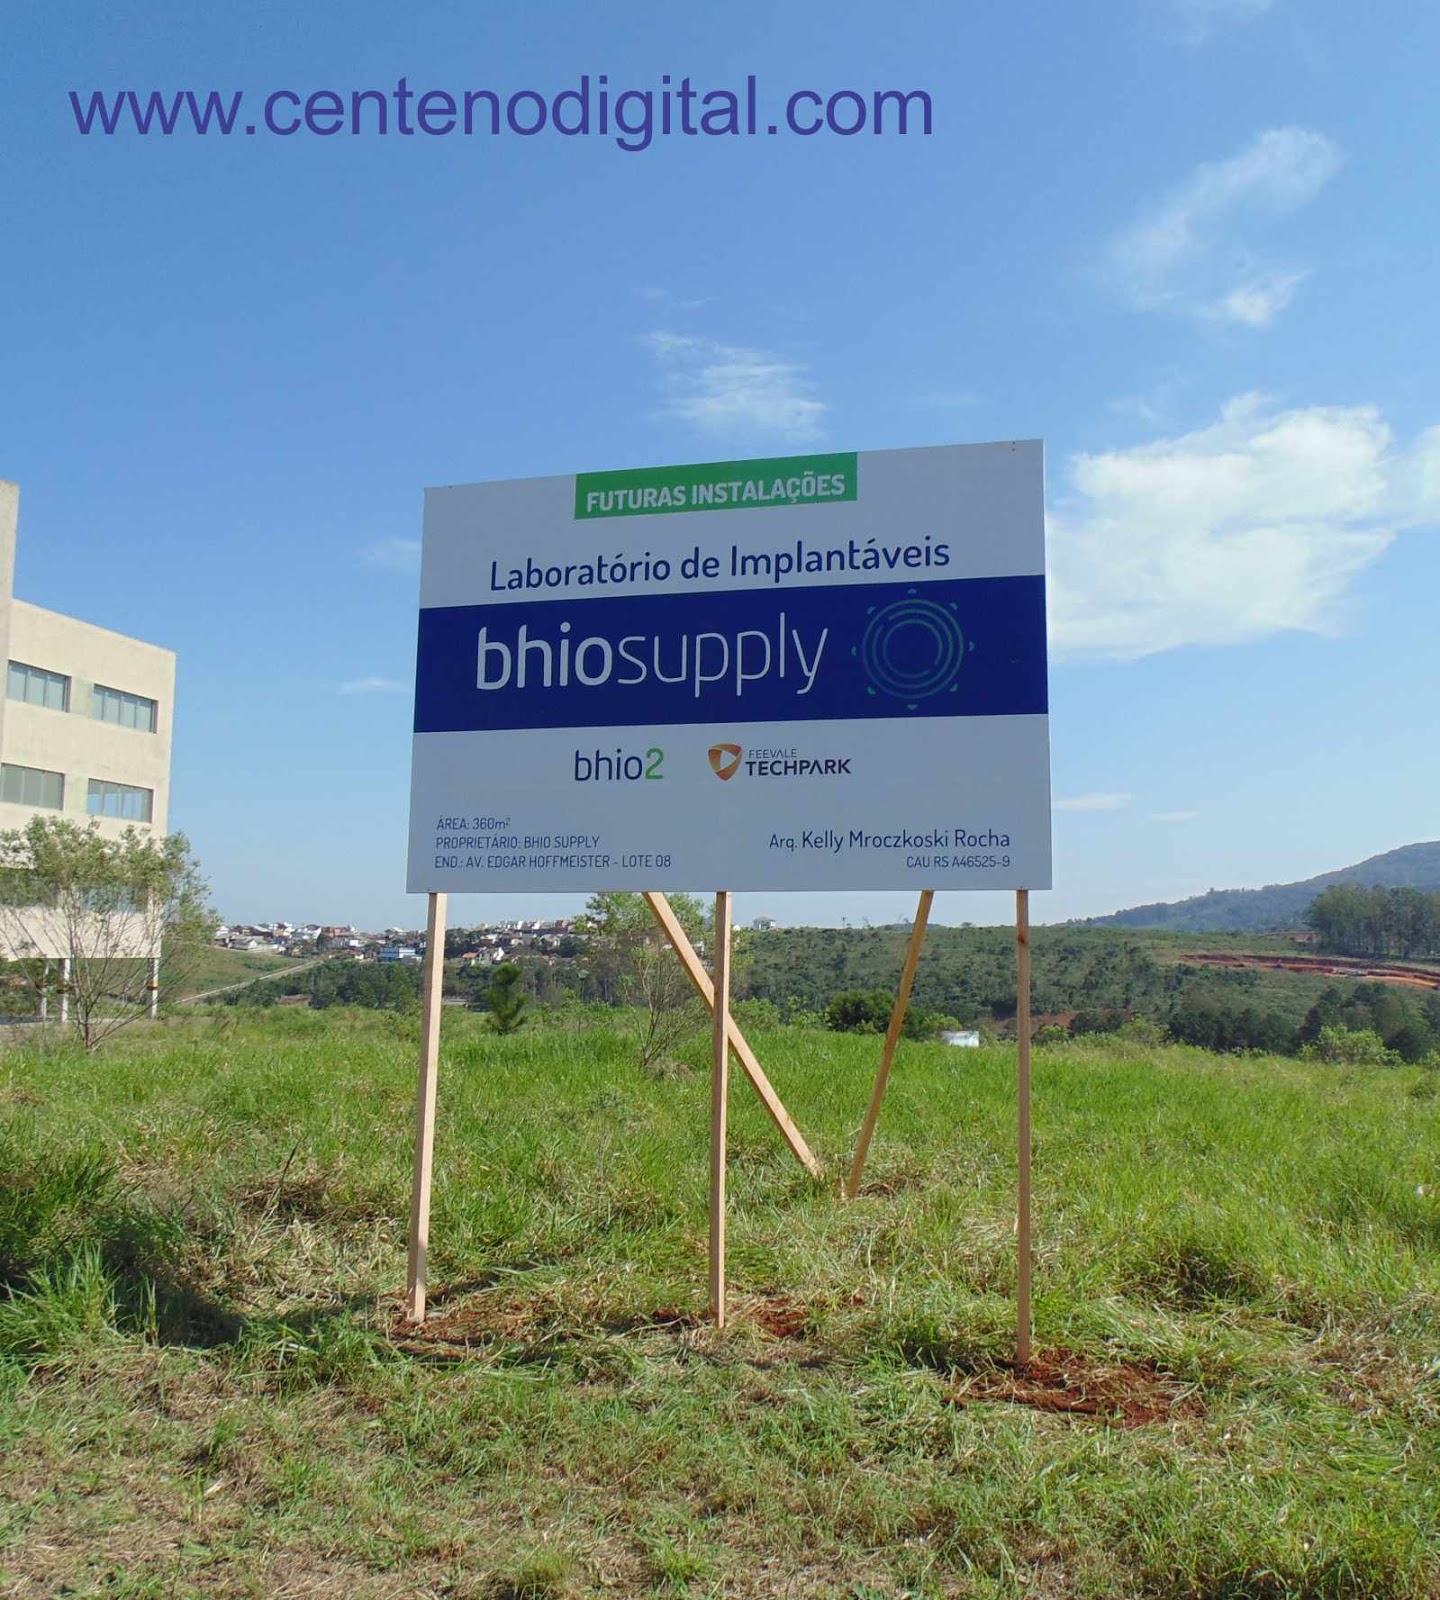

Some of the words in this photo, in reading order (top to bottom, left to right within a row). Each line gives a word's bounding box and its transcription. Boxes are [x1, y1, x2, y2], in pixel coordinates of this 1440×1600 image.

[586, 485, 686, 512] FUTURAS
[691, 470, 846, 506] INSTALAÇÕES
[490, 552, 671, 592] Laboratório
[680, 546, 720, 579] de
[730, 535, 951, 582] Implantáveis
[476, 612, 829, 698] bhiosupply
[748, 748, 798, 759] FEEVALE
[574, 747, 665, 782] bhio2
[745, 758, 851, 776] TECHPARK
[436, 815, 469, 830] ÁREA:
[436, 834, 521, 850] PROPRIETÁRIO:
[524, 836, 551, 849] BHIO
[554, 836, 600, 849] SUPPLY
[769, 833, 798, 849] Arq.
[801, 830, 844, 853] Kelly
[849, 829, 949, 849] Mroczkoski
[954, 829, 1010, 847] Rocha
[465, 855, 484, 869] AV.
[487, 855, 526, 869] EDGAR
[528, 854, 610, 868] HOFFMEISTER
[621, 854, 652, 868] LOTE
[655, 854, 671, 868] 08
[906, 856, 931, 868] CAU
[933, 856, 949, 868] RS
[951, 855, 1010, 868] A46525-9
